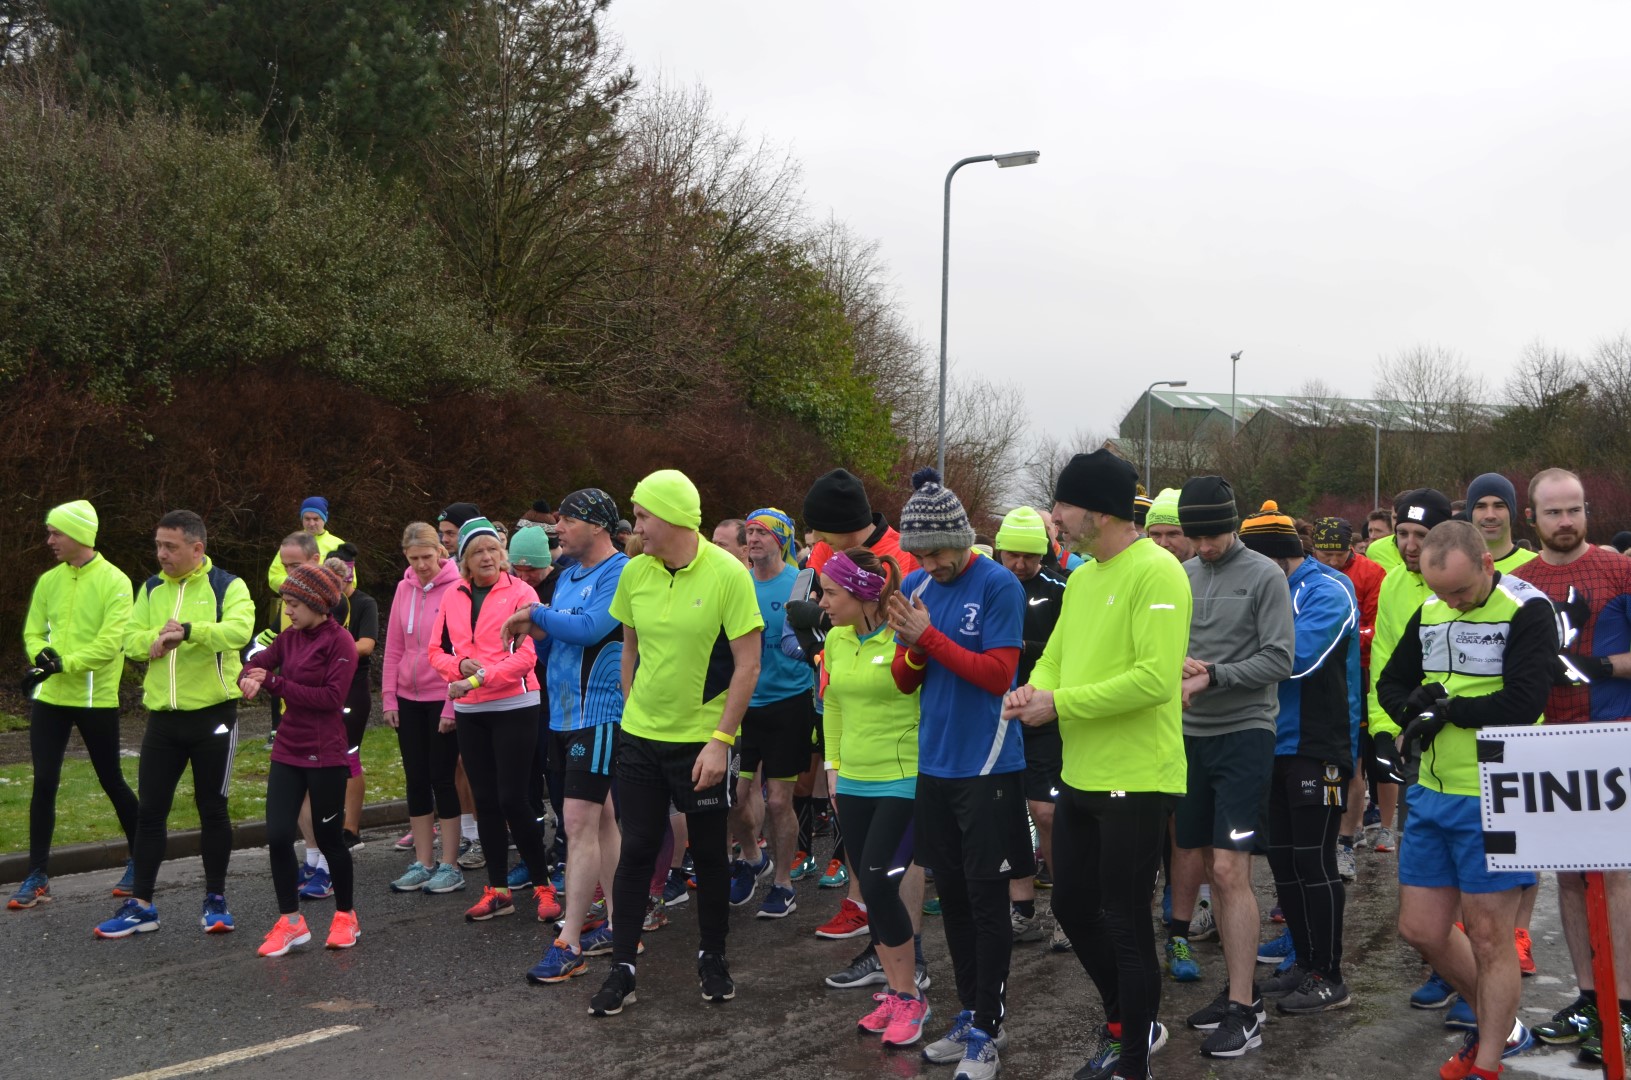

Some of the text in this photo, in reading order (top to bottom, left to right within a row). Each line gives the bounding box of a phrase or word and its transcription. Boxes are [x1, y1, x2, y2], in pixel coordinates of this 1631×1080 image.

[1301, 780, 1317, 788] PMC
[1490, 766, 1631, 814] FINIS
[697, 797, 719, 806] O'NEILLS
